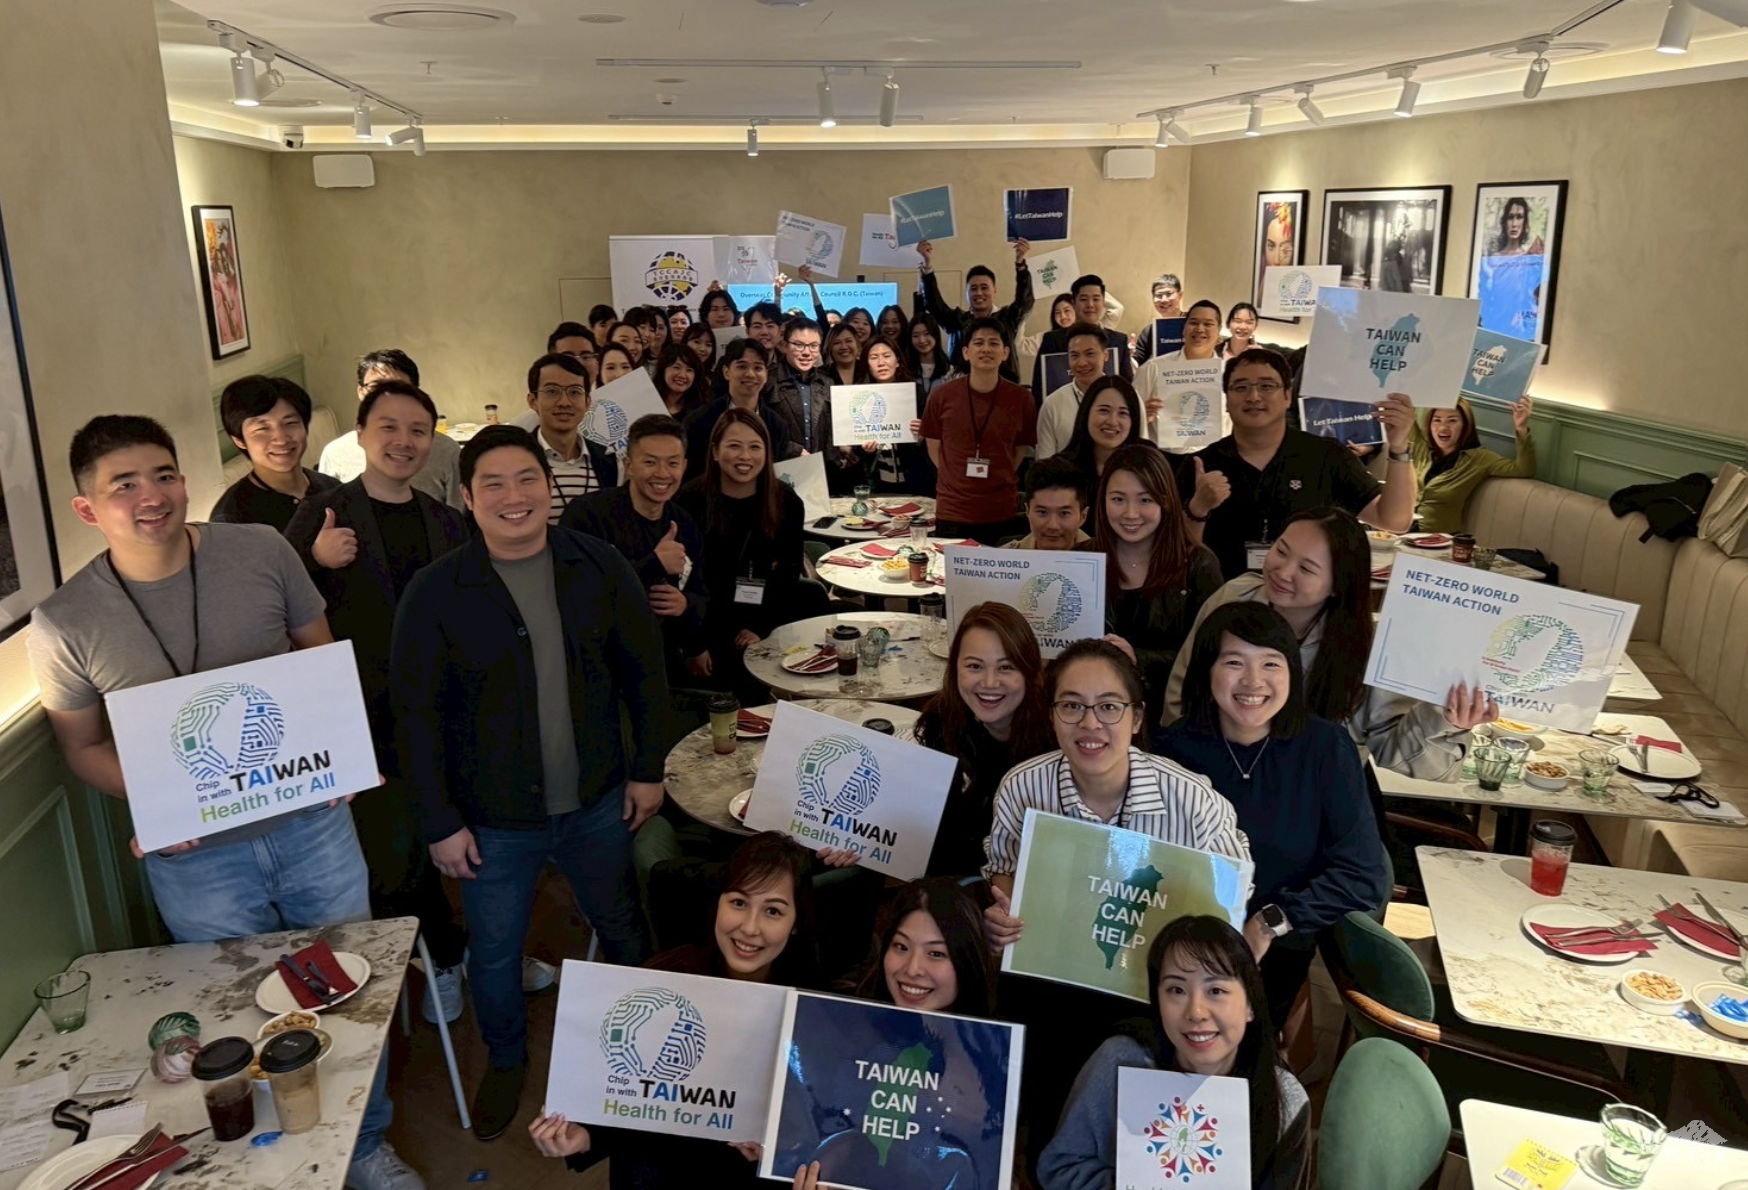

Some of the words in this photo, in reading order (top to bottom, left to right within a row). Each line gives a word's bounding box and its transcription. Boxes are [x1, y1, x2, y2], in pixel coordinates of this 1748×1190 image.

[1014, 211, 1063, 219] #LetTaiwanHelp
[1366, 328, 1421, 344] TAIWAN
[1376, 344, 1405, 357] CAN
[1473, 349, 1506, 363] TAIWAN
[1369, 358, 1407, 372] HELP
[1472, 366, 1495, 377] HELP
[1477, 359, 1494, 369] CAN
[854, 432, 877, 440] Health
[891, 431, 902, 439] All
[953, 556, 996, 568] NET-ZERO
[997, 559, 1030, 569] WORLD
[953, 567, 987, 579] TAIWAN
[987, 571, 1021, 581] ACTION
[1403, 584, 1450, 603] TAIWAN
[1452, 597, 1502, 615] ACTION
[1406, 570, 1469, 592] NET-ZERO
[1471, 585, 1520, 605] WORLD
[196, 779, 220, 793] Chip
[198, 794, 208, 803] in
[209, 788, 232, 801] with
[229, 750, 332, 793] TAIWAN
[200, 792, 269, 823] Health
[274, 783, 303, 803] for
[309, 772, 335, 793] All
[796, 800, 815, 812] Chip
[803, 813, 819, 822] with
[821, 808, 898, 847] TAIWAN
[790, 819, 840, 847] Health
[844, 837, 867, 855] for
[869, 848, 892, 864] All
[1088, 875, 1168, 910] TAIWAN
[1101, 903, 1145, 928] CAN
[1091, 923, 1147, 949] HELP
[607, 1074, 630, 1087] Chip
[855, 1060, 940, 1091] TAIWAN
[606, 1085, 615, 1095] in
[617, 1086, 637, 1097] with
[639, 1080, 736, 1109] TAIWAN
[871, 1090, 917, 1114] CAN
[603, 1099, 667, 1122] Health
[673, 1108, 702, 1126] for
[707, 1111, 734, 1130] All
[862, 1114, 921, 1141] HELP
